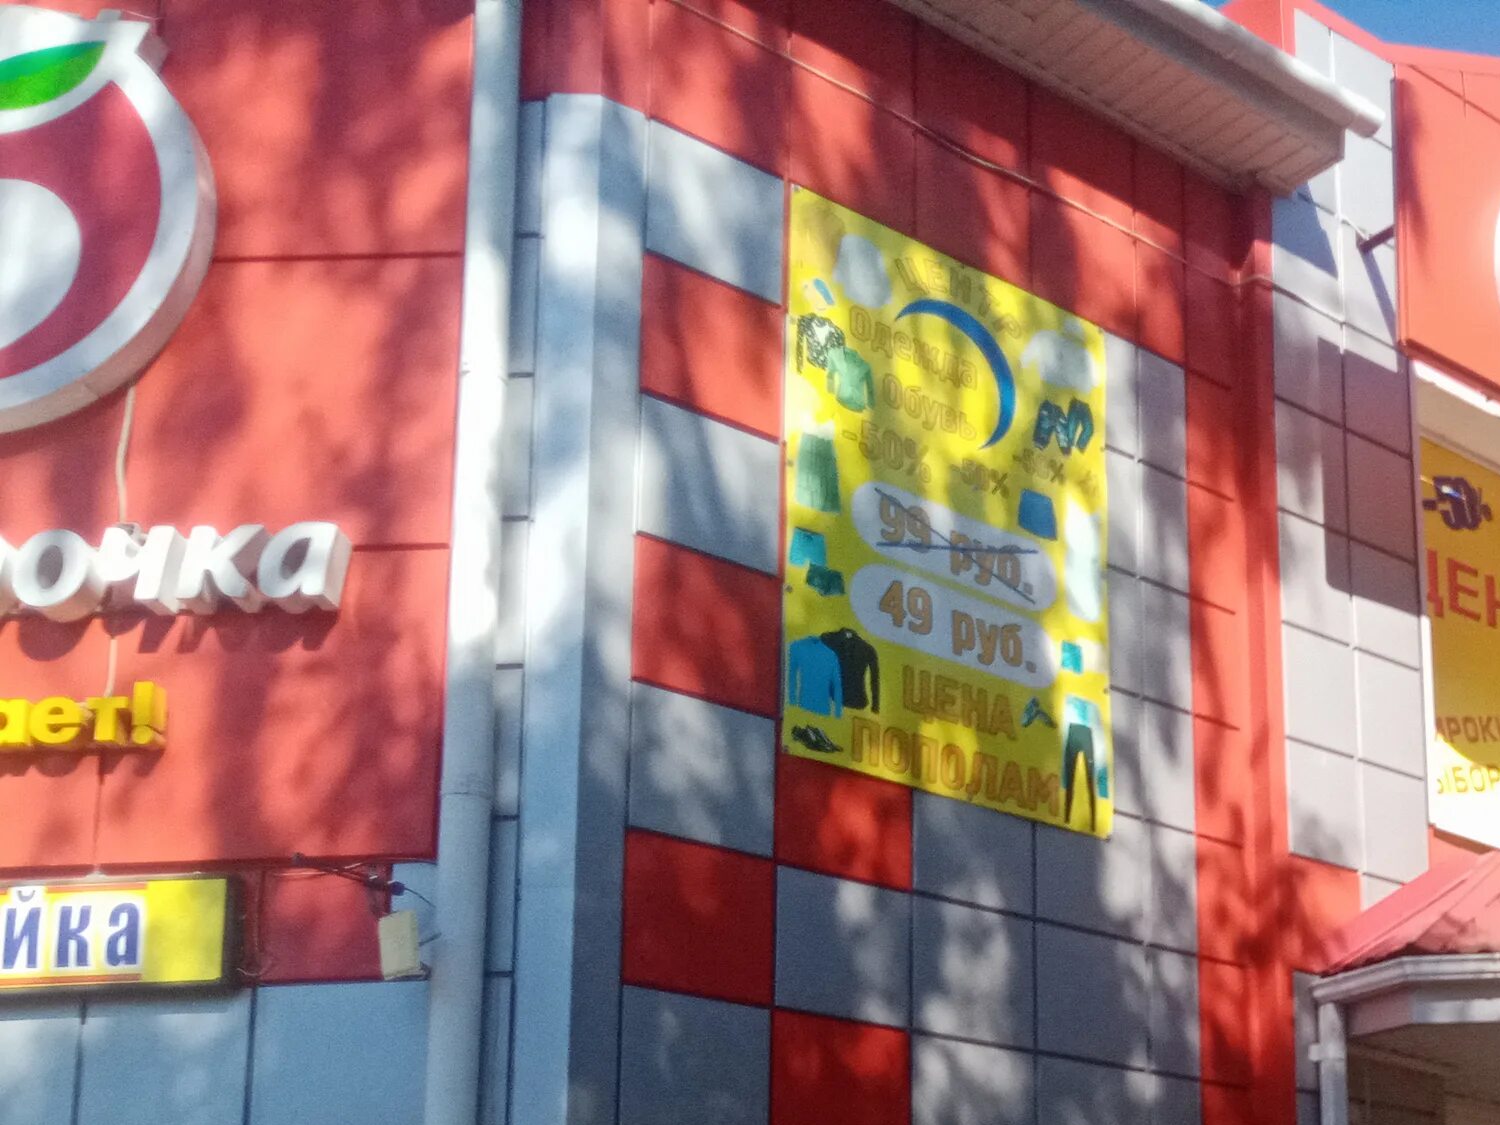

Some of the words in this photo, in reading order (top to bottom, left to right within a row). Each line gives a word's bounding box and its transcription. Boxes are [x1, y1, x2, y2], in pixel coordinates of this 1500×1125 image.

[849, 303, 978, 390] Одежда
[881, 364, 978, 441] Обувь
[878, 494, 933, 553] 99
[0, 521, 352, 622] очка
[878, 579, 934, 637] 49
[950, 608, 1037, 674] руб.
[901, 662, 1018, 742] ЦЕНА
[851, 716, 1061, 817] ПОПОЛАМ
